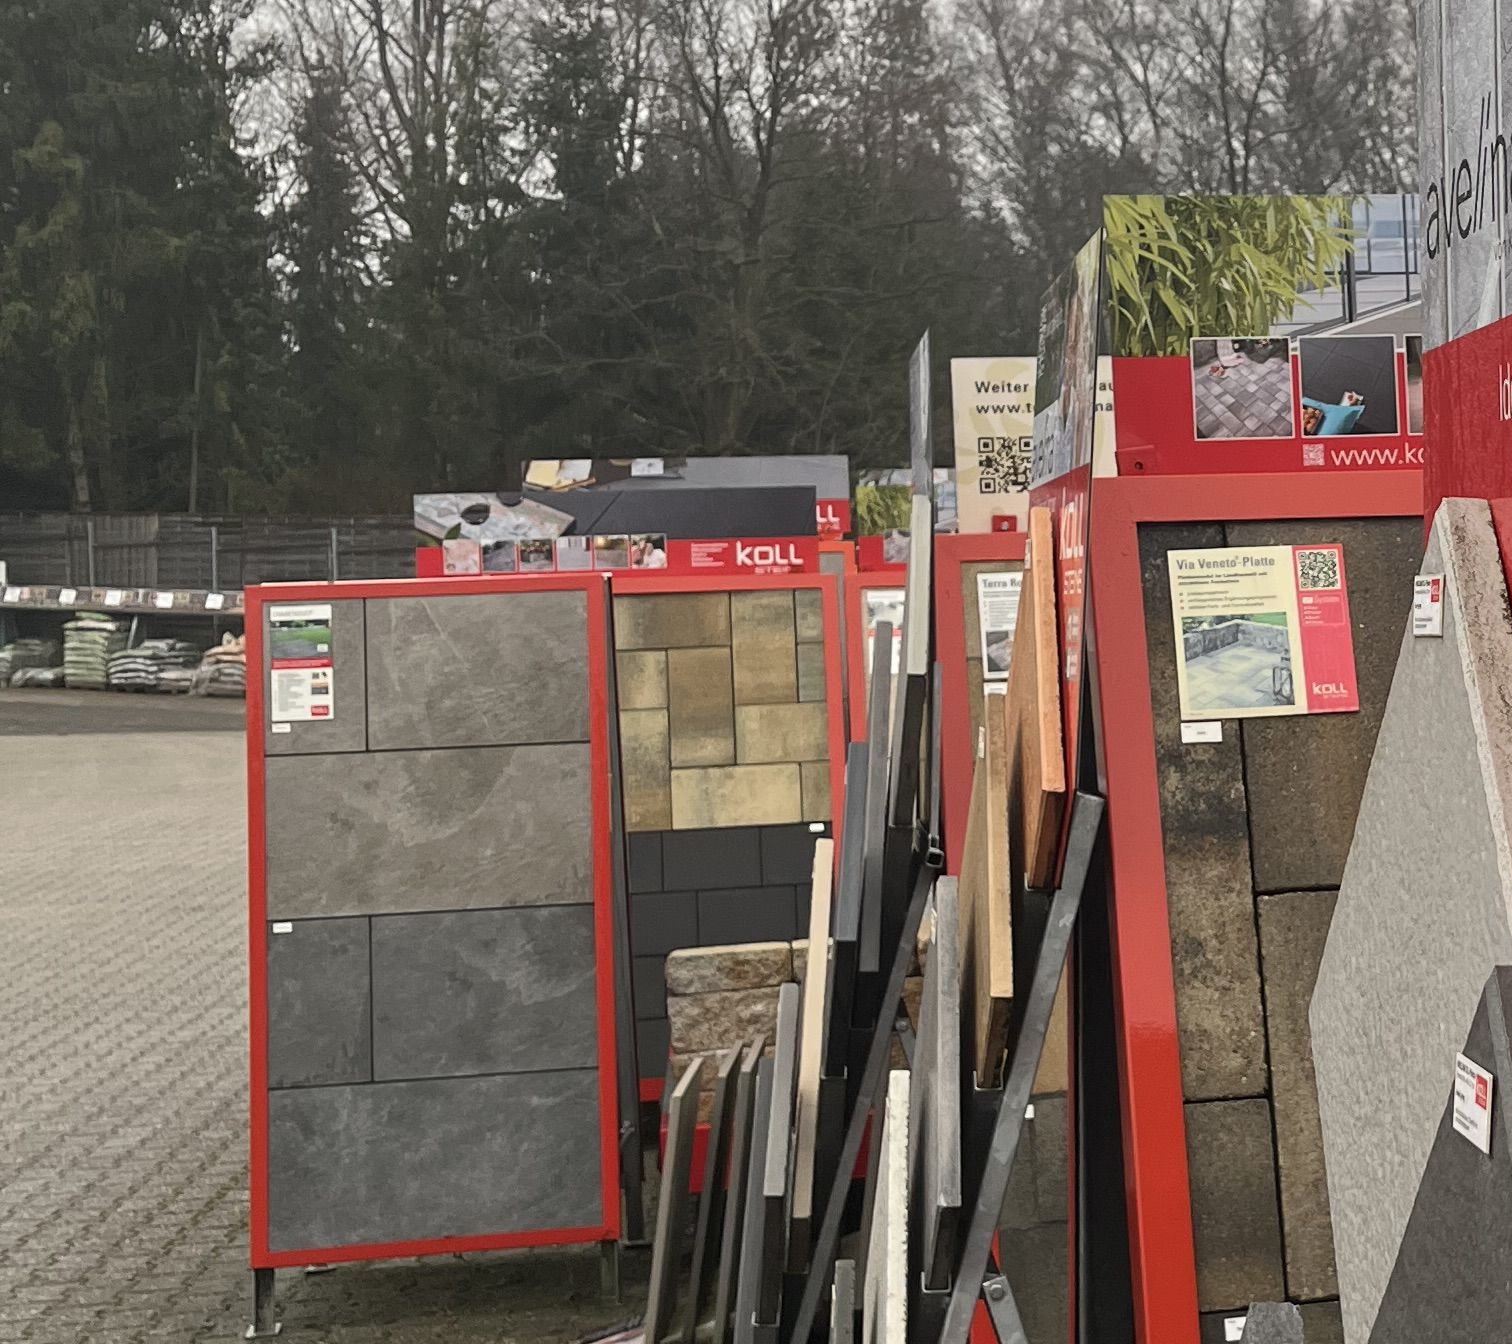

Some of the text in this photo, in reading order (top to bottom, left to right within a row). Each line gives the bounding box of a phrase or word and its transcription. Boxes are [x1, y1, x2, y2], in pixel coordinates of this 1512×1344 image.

[975, 381, 1030, 394] Weiter
[736, 540, 804, 567] KOLL
[1176, 559, 1195, 570] Via
[982, 578, 1008, 589] Terra
[1312, 681, 1349, 695] KOLL
